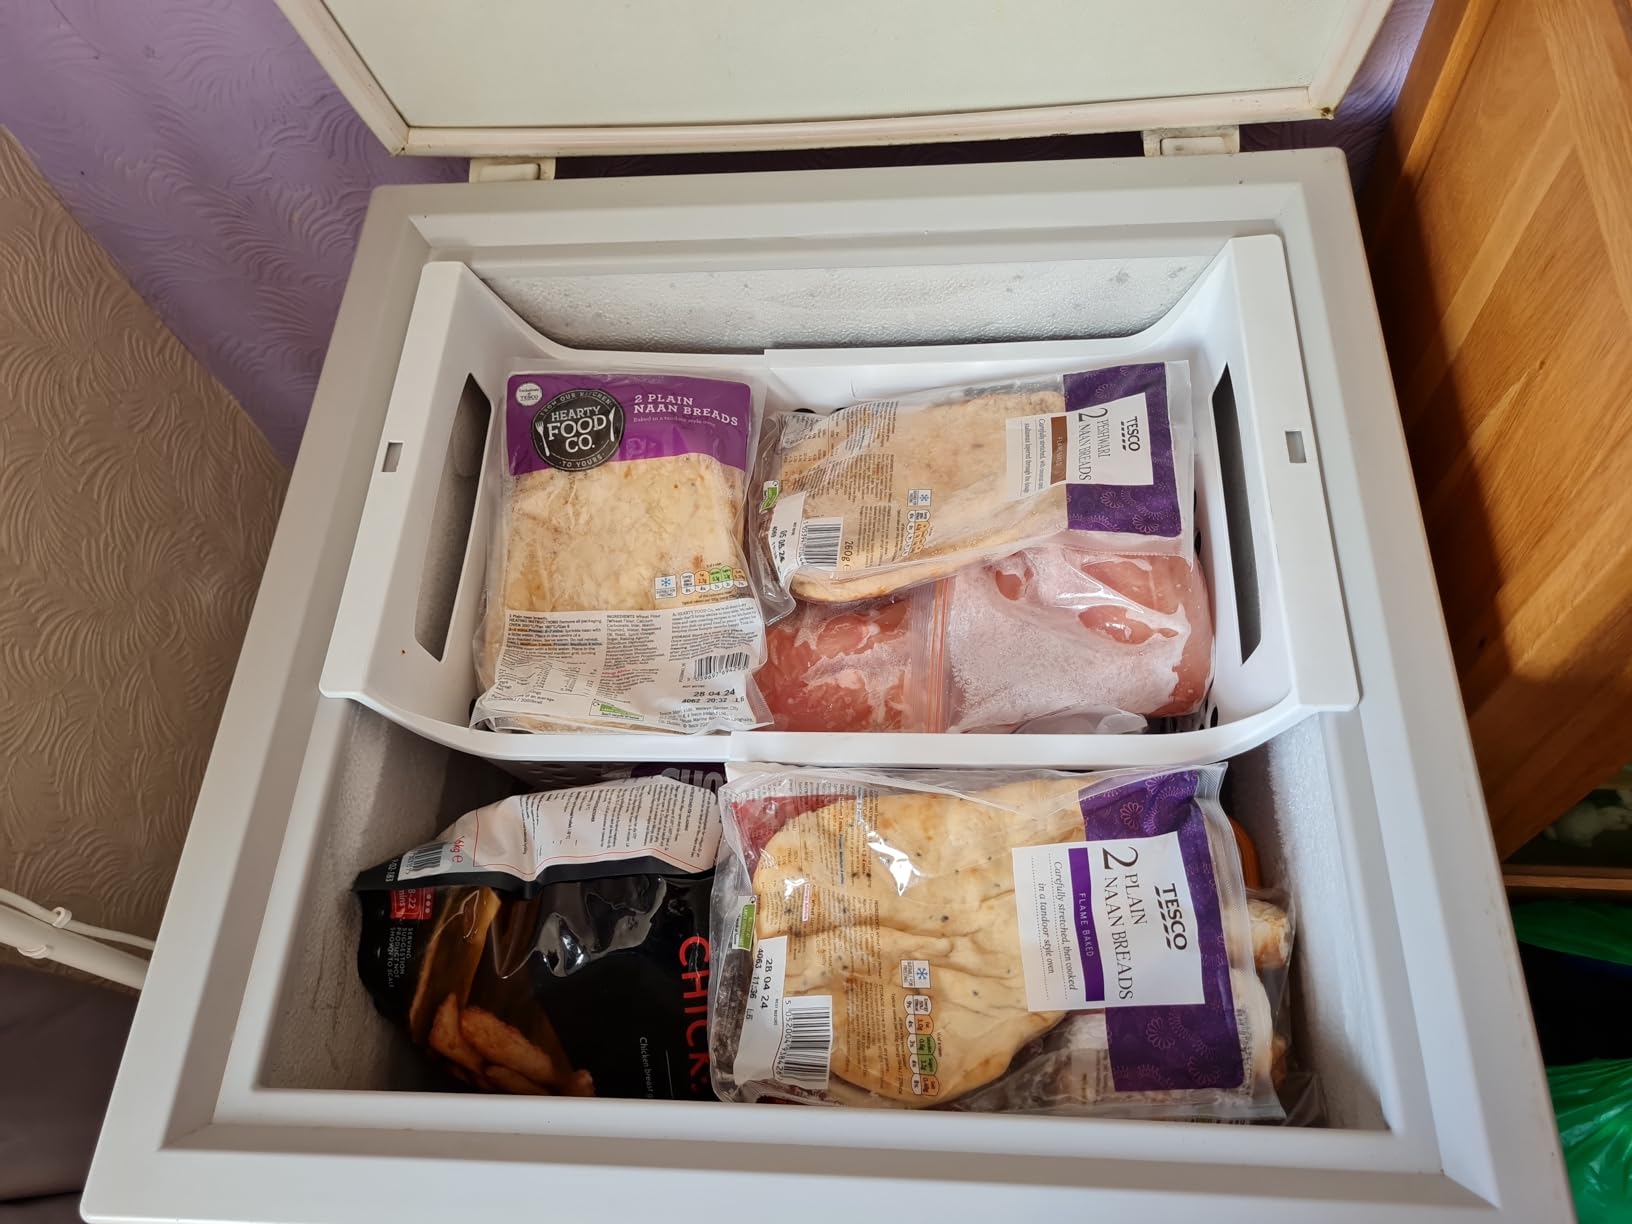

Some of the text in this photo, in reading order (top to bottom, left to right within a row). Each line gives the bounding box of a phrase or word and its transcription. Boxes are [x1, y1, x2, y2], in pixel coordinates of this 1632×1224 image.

[560, 392, 577, 402] OUR
[634, 393, 694, 406] 2 PLAIN
[546, 414, 607, 441] FOOD
[551, 405, 601, 422] HEARTY
[633, 404, 739, 427] NAAN BREADS
[1078, 407, 1109, 423] 2
[565, 434, 596, 453] CO.
[1097, 418, 1111, 458] PESHWARI
[1127, 415, 1141, 452] TESCO
[562, 454, 603, 468] TO YOURS
[1078, 424, 1092, 481] NAAN BREADS
[841, 540, 854, 562] 260g
[724, 688, 736, 697] 24
[1102, 846, 1140, 870] 2
[1038, 883, 1046, 892] in
[1124, 873, 1148, 926] PLAIN
[1039, 900, 1050, 936] tandoor
[1054, 861, 1079, 991] Carefully stretched, then cooked
[1078, 892, 1094, 957] FLAME BAKED
[1162, 882, 1188, 951] TESCO
[393, 927, 401, 962] PRODUCT
[400, 927, 408, 975] SUGGESTION
[406, 927, 414, 960] SERVING
[1042, 938, 1053, 957] style
[1104, 876, 1134, 1000] NAAN BREADS
[387, 927, 396, 988] SHOWN TO SCALE
[754, 948, 764, 969] 4063
[1047, 957, 1055, 974] oven
[749, 976, 760, 999] 11:36
[760, 958, 774, 1009] 28 04 24
[679, 936, 711, 1092] CHICK
[639, 1036, 654, 1093] Chicken breast
